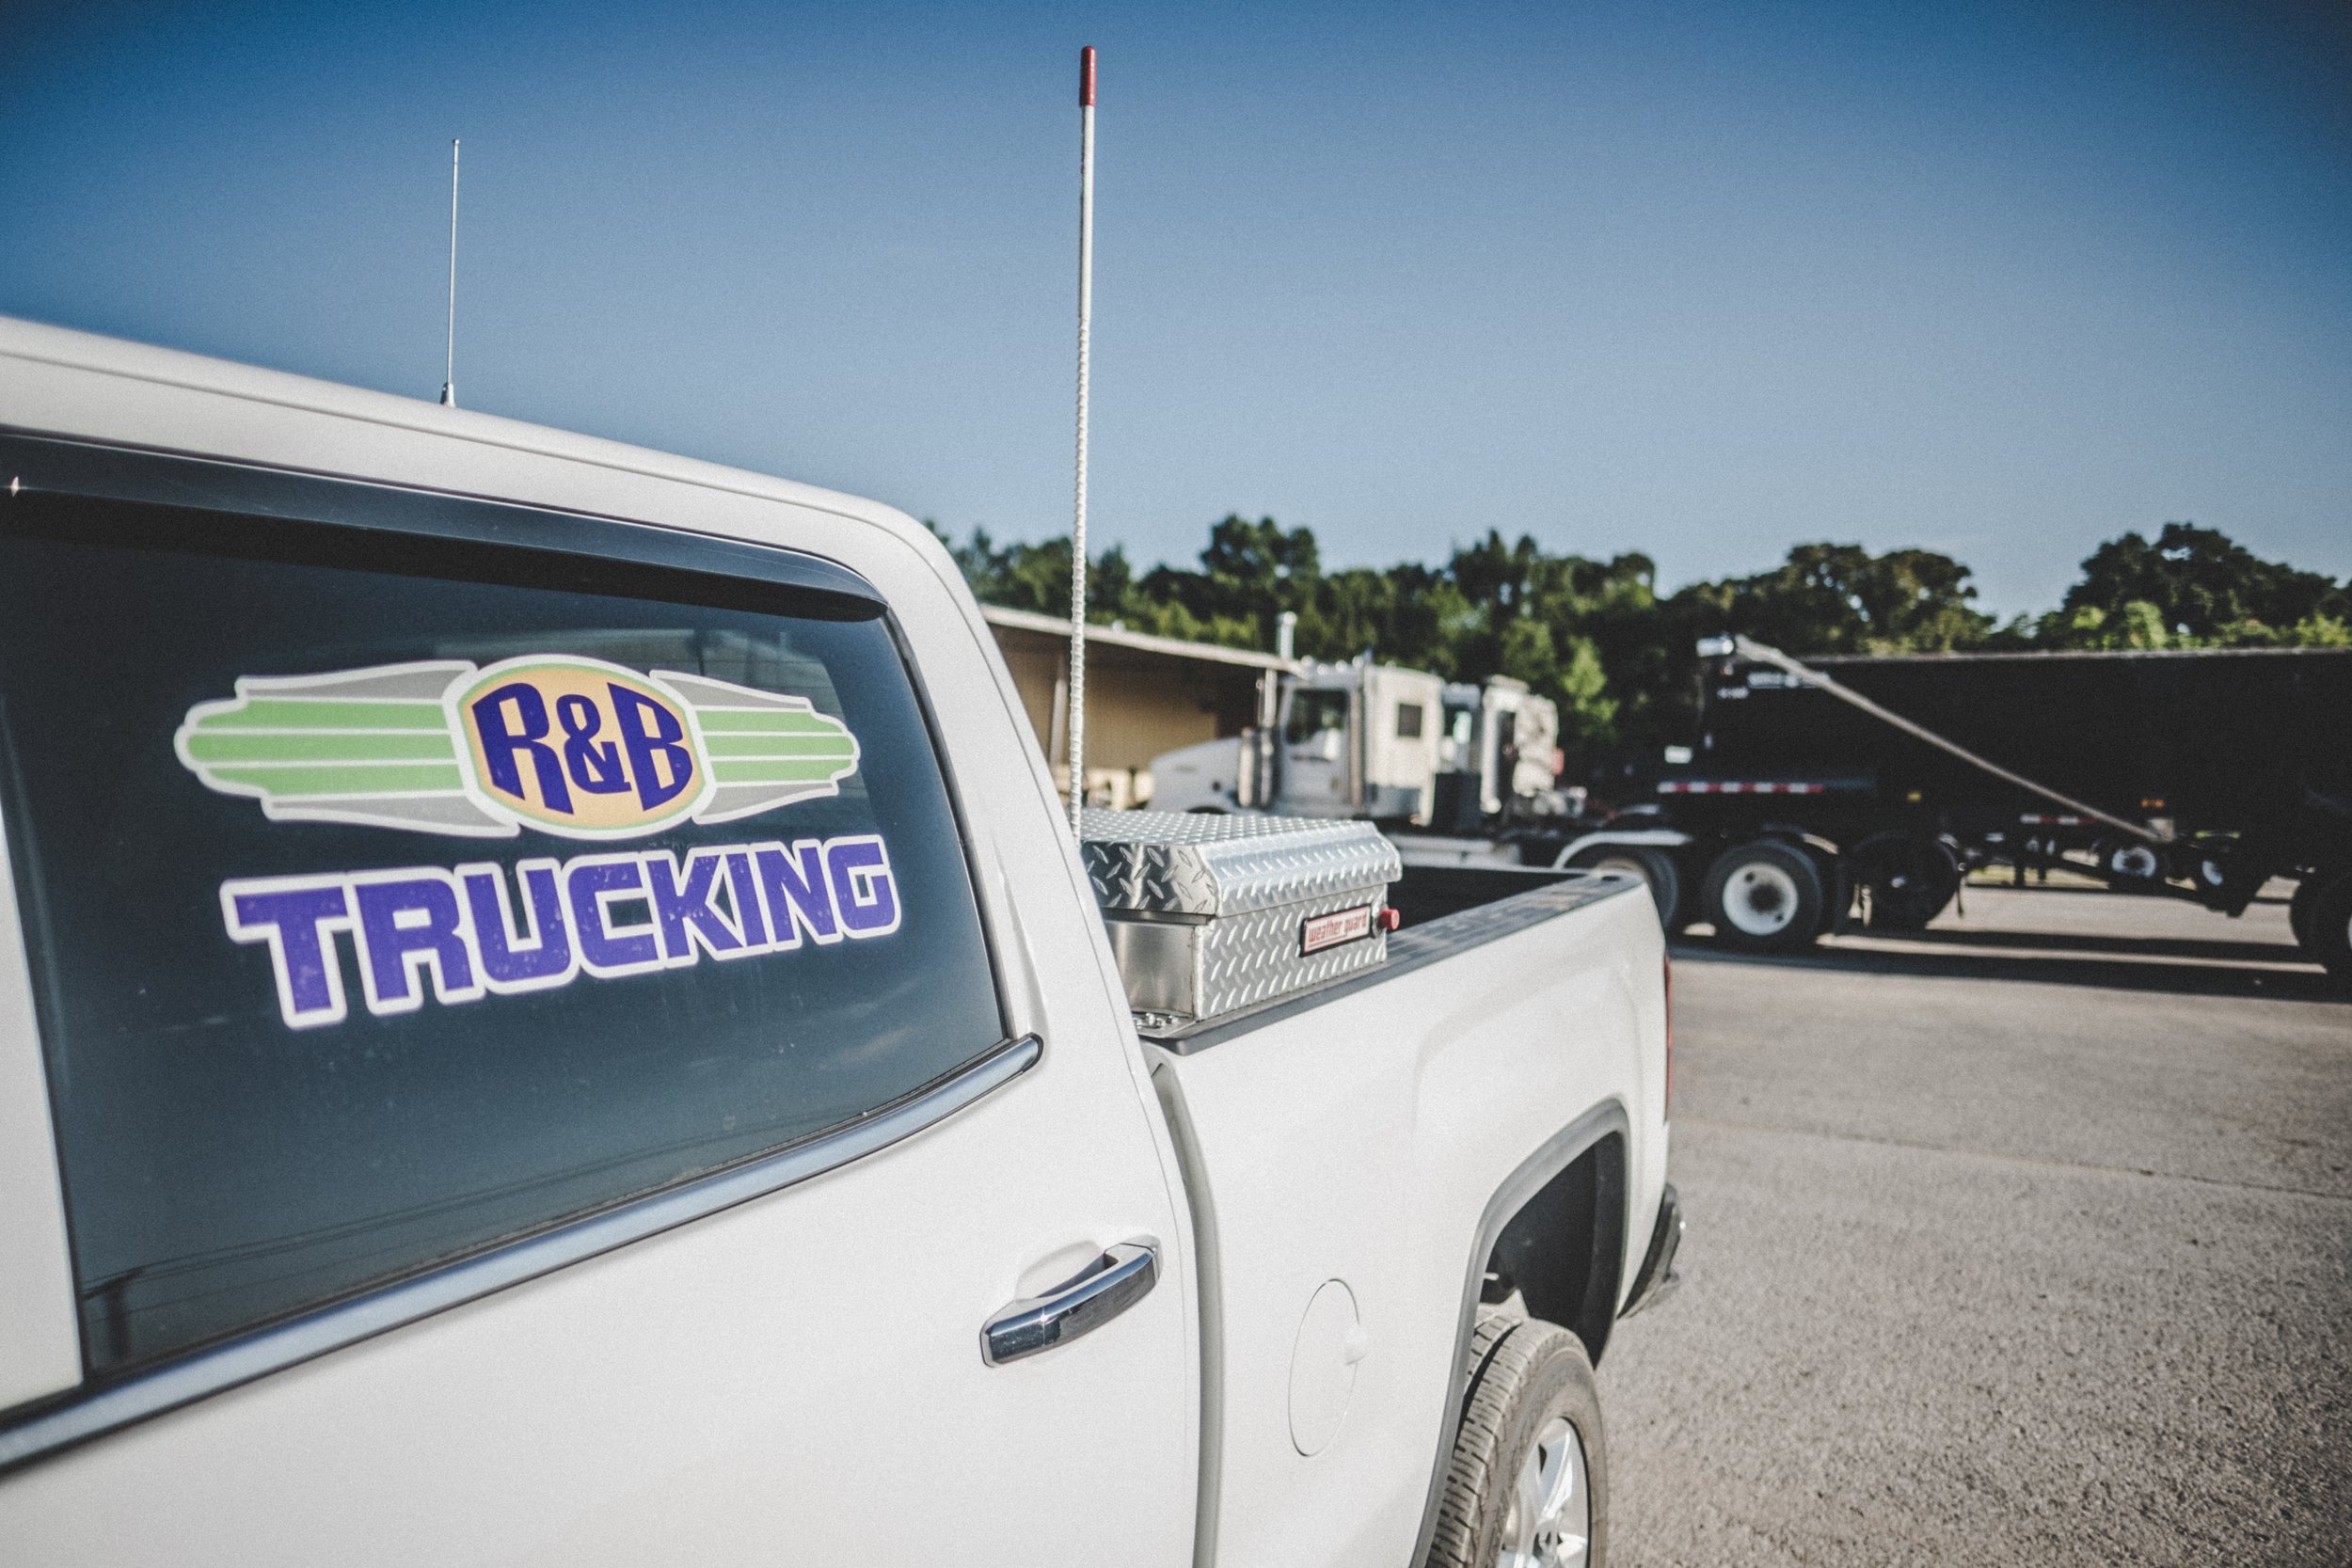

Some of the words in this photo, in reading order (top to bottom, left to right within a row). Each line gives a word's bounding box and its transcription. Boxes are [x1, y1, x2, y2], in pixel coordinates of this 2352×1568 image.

[471, 681, 693, 816] R&B
[226, 837, 899, 1025] TRUCKING
[1309, 919, 1343, 942] weather
